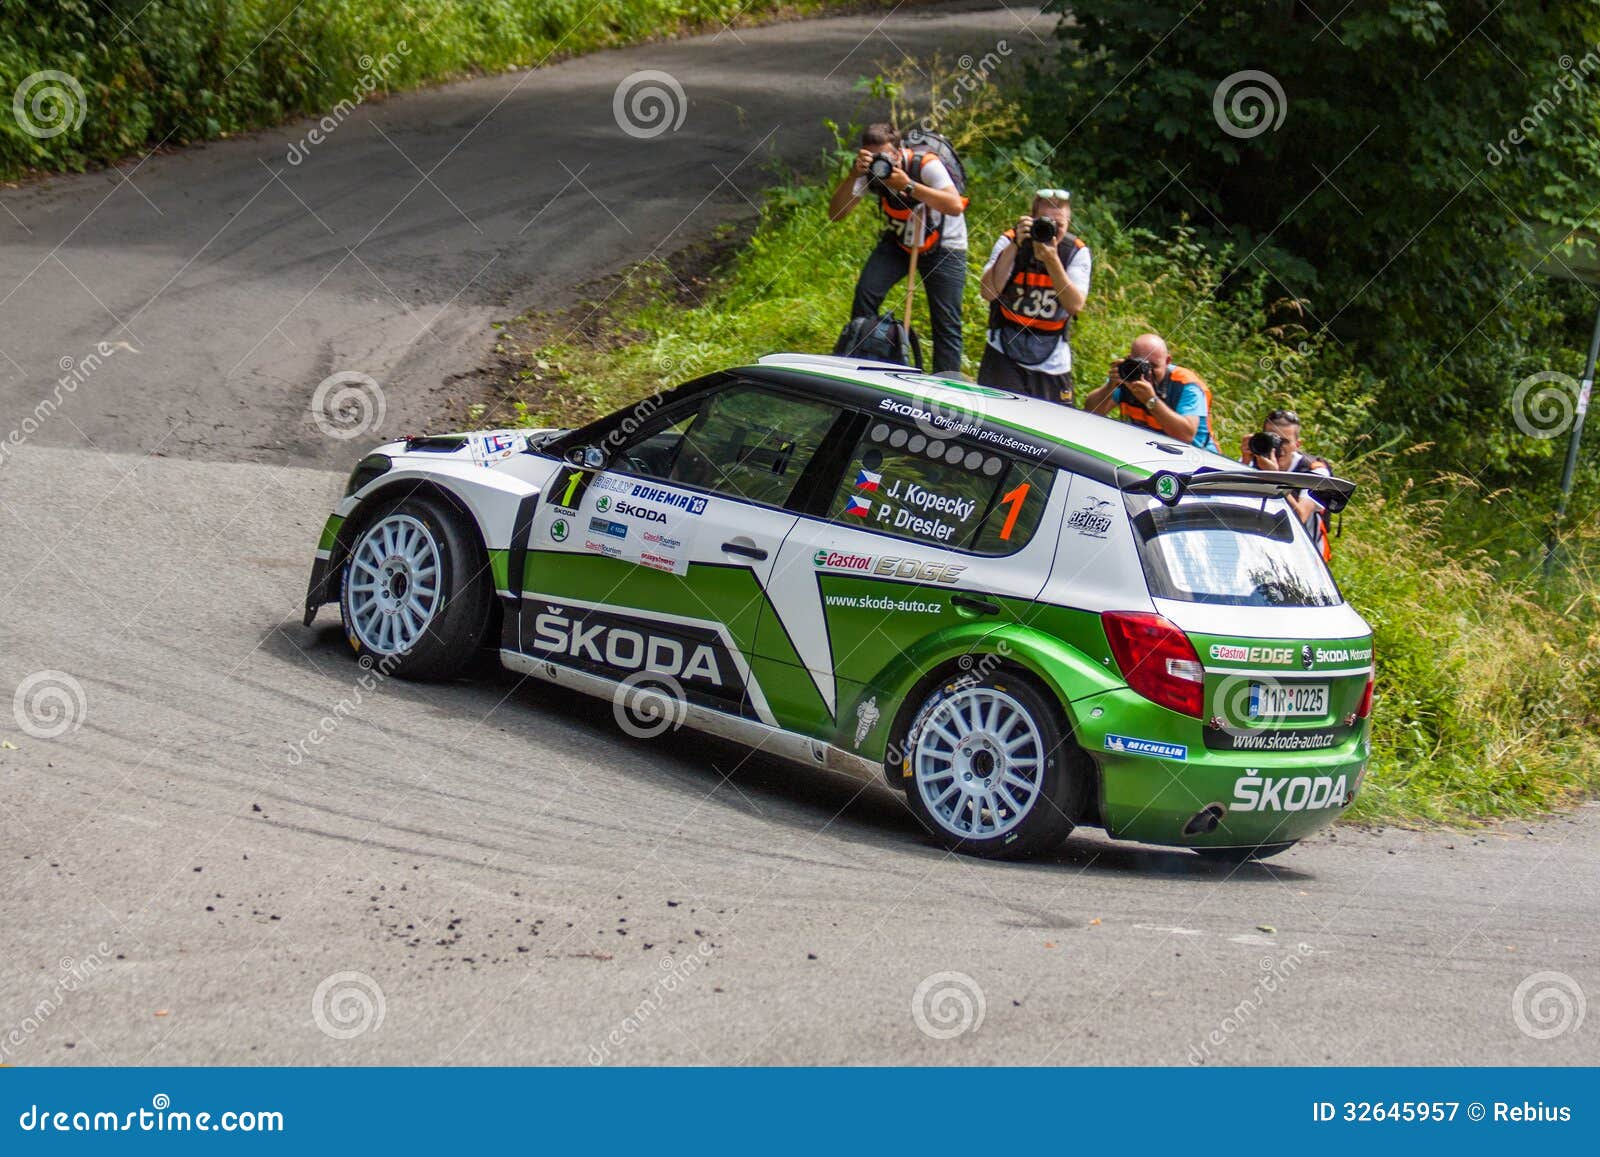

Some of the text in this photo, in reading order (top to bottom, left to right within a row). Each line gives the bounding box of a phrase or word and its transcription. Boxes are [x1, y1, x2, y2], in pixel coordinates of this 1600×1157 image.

[879, 398, 932, 422] ŠKODA
[934, 415, 982, 437] Originální
[562, 471, 585, 508] 1
[631, 485, 690, 508] BOHEMIA
[886, 480, 975, 522] J. Kopecký
[553, 506, 576, 518] ŠKODA
[614, 501, 667, 525] ŠKODA
[876, 503, 956, 541] P. Dresler
[1000, 483, 1031, 540] 1
[826, 552, 968, 583] Castrol EDGE
[826, 594, 942, 613] www.skoda-auto.cz
[533, 605, 723, 686] ŠKODA
[1220, 647, 1247, 660] Castrol
[1249, 648, 1294, 664] EDGE
[1316, 647, 1349, 662] ŠKODA
[1295, 688, 1323, 712] 0225
[1127, 740, 1184, 757] MICHELIN
[1232, 732, 1335, 750] www.skoda-auto.cz
[1228, 768, 1347, 812] ŠKODA
